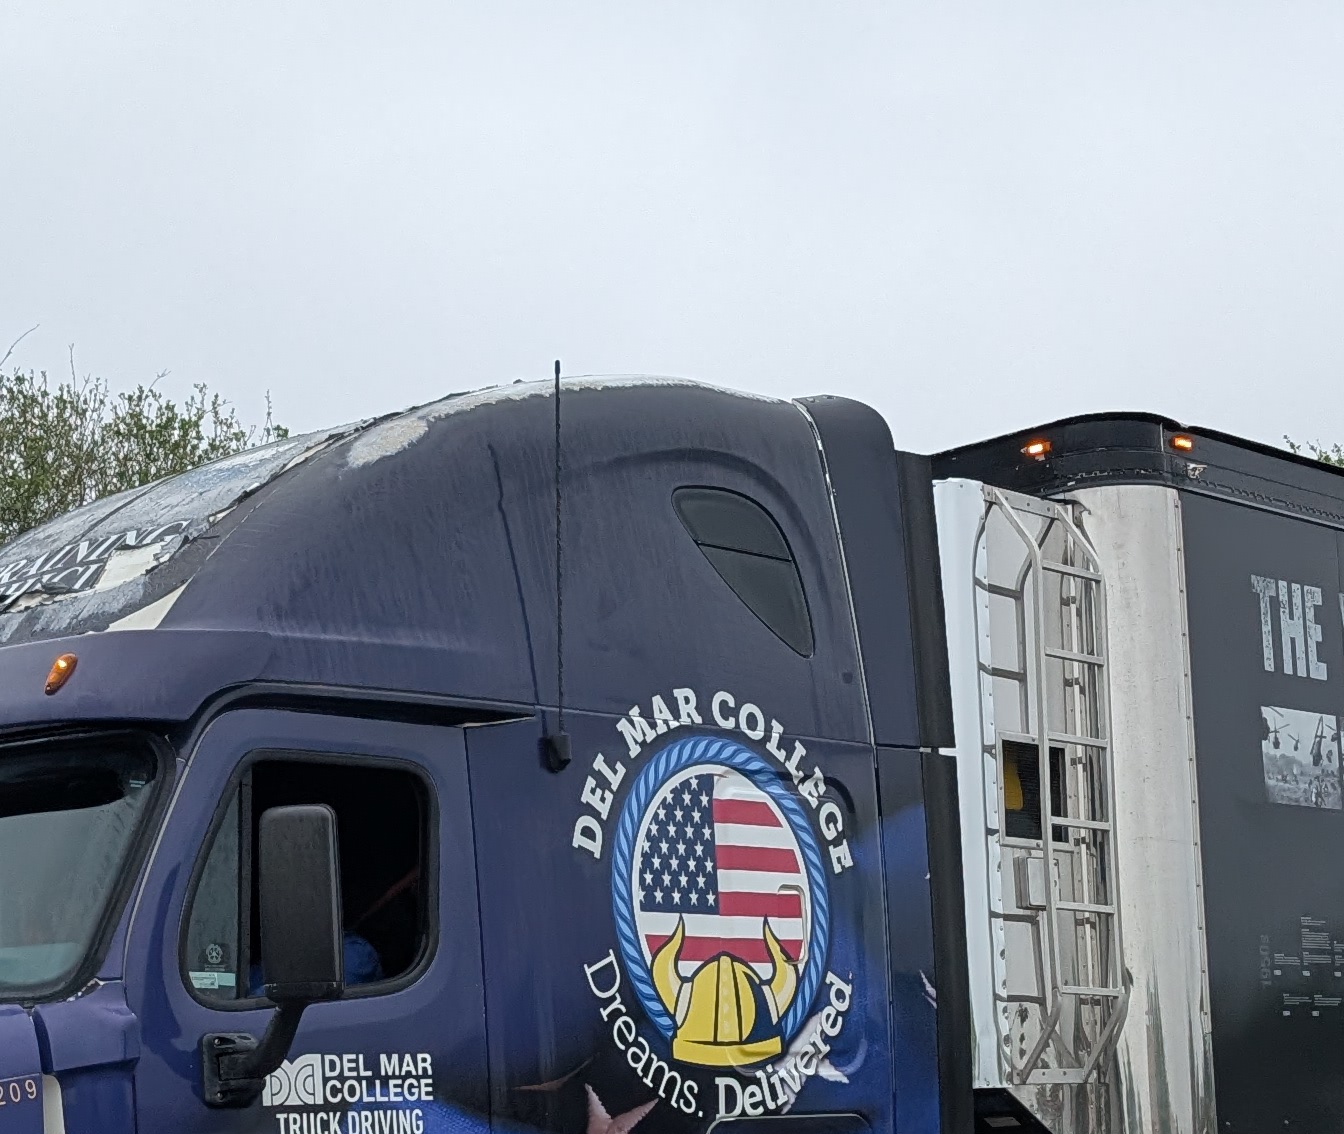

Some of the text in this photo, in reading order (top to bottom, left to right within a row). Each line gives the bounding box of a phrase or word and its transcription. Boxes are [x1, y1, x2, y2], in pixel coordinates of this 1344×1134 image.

[1250, 573, 1328, 681] THE
[572, 687, 853, 874] DEL MAR COLLEGE
[324, 1053, 433, 1077] DEL MAR
[584, 949, 703, 1118] Dreams.
[325, 1078, 434, 1104] COLLEGE
